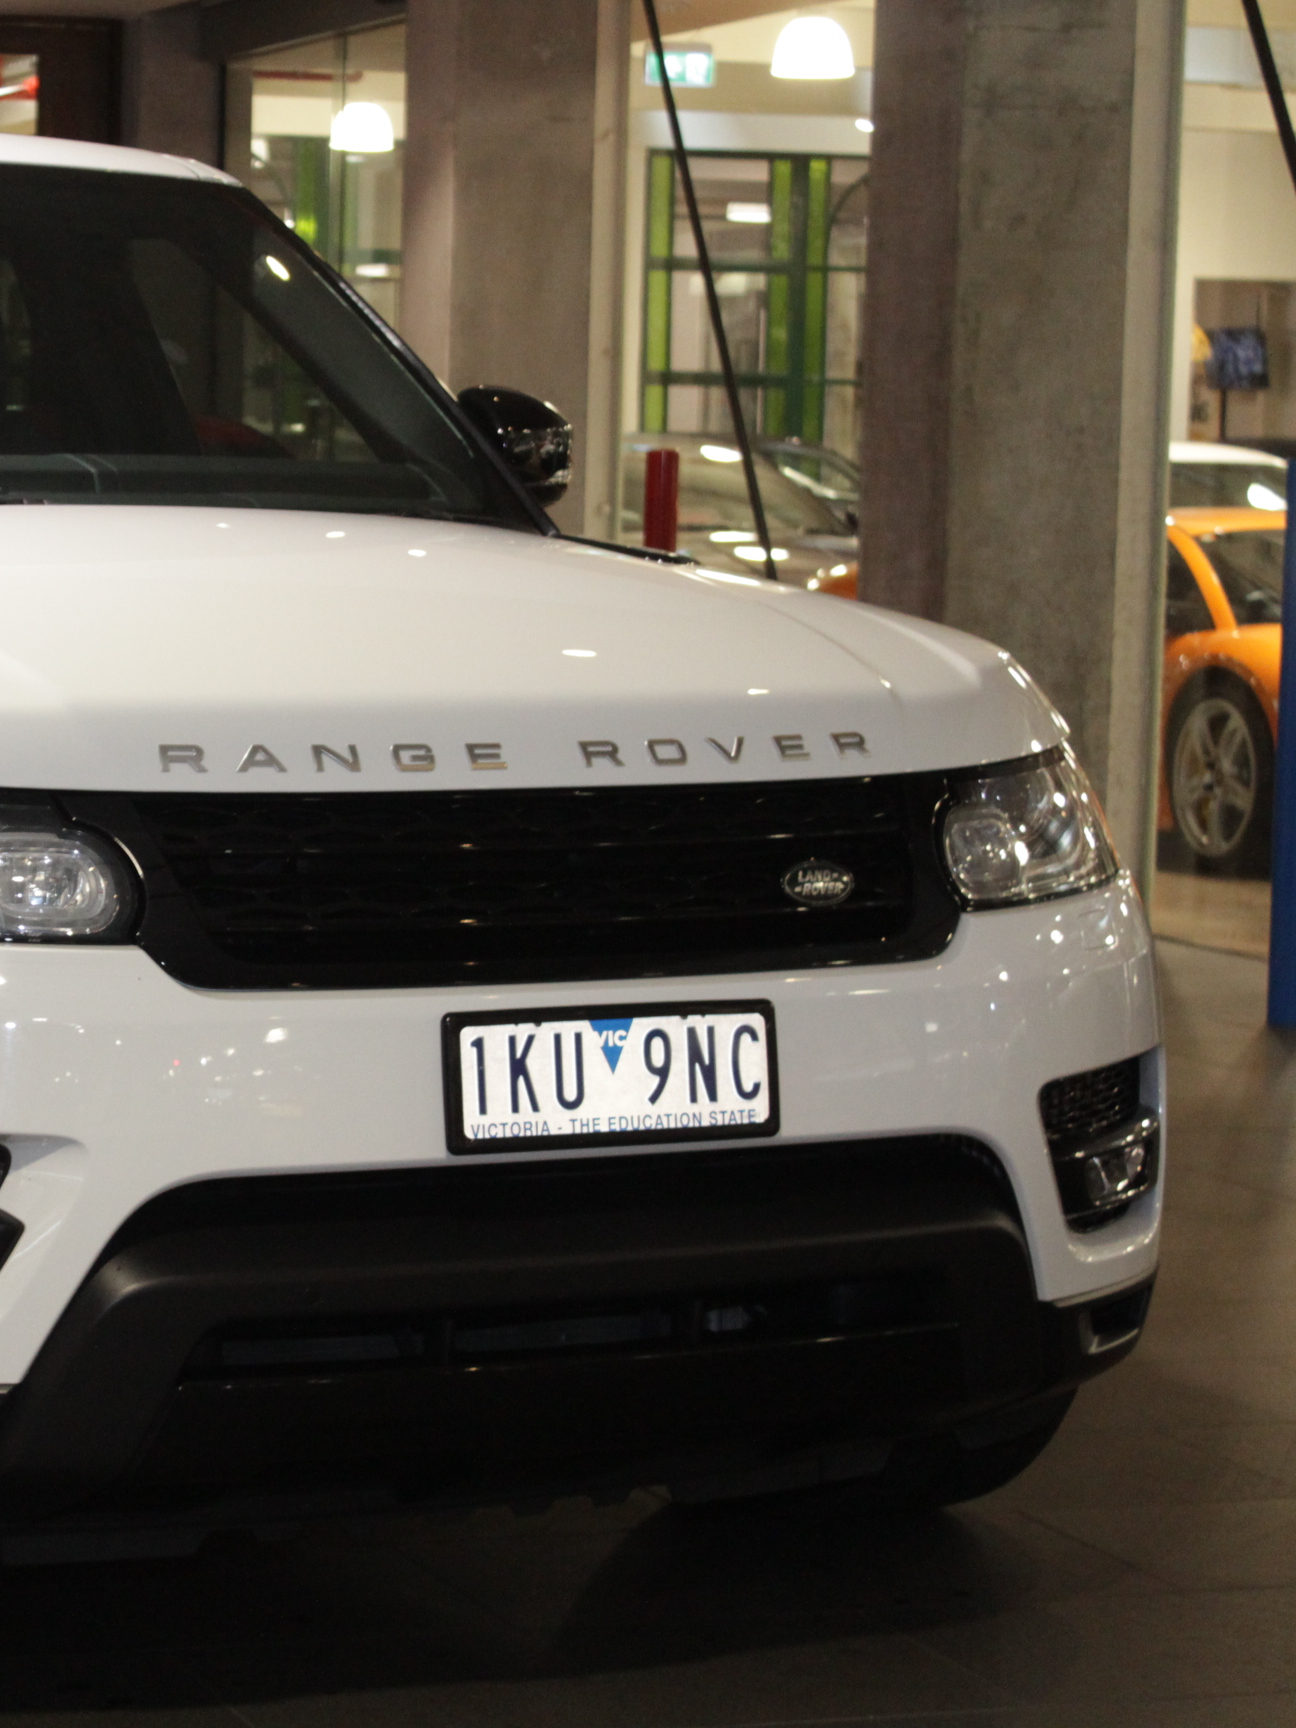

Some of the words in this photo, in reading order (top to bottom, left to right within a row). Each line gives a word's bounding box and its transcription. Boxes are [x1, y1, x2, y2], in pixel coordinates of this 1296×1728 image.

[157, 742, 508, 774] RANGE
[577, 731, 872, 767] ROVER
[596, 1030, 628, 1048] VIC
[469, 1031, 585, 1116] 1KU
[642, 1024, 762, 1106] 9NC
[470, 1121, 551, 1140] VICTORIA
[570, 1117, 602, 1134] THE
[608, 1112, 702, 1132] EDUCATION
[709, 1109, 757, 1126] STATE
